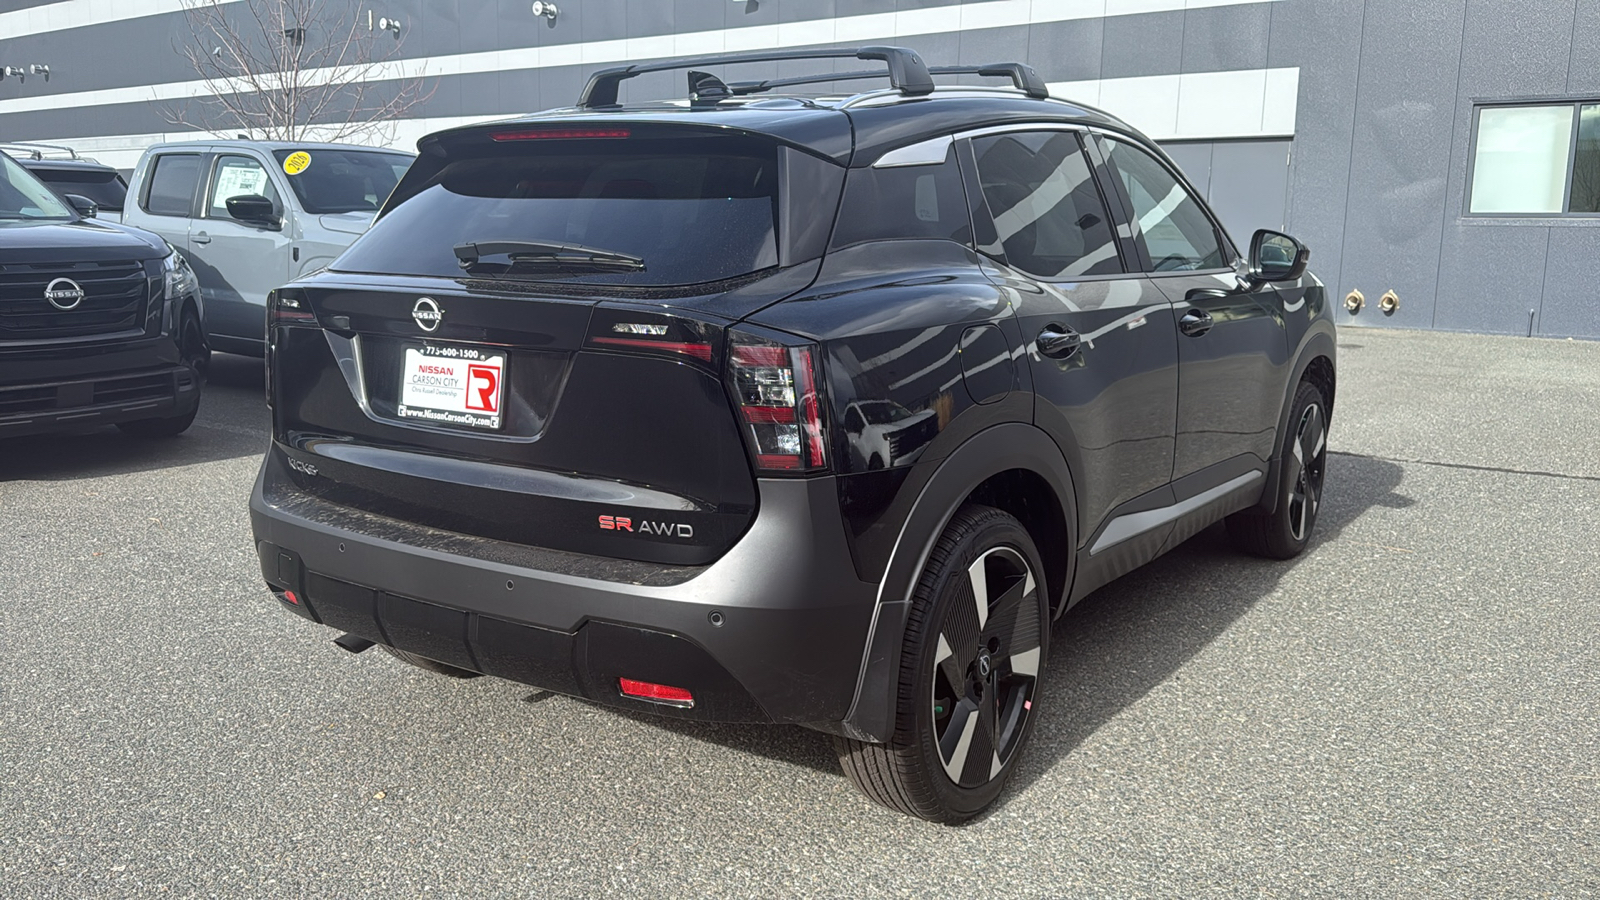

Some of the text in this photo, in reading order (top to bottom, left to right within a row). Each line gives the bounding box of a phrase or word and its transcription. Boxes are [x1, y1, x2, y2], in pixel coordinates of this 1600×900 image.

[288, 153, 308, 171] 2026
[44, 290, 84, 298] NISSAN
[412, 311, 442, 320] NISSAN
[426, 346, 478, 359] 775-600-1500
[418, 365, 454, 376] NISSAN
[412, 374, 459, 387] CARSON CITY
[472, 369, 496, 411] R
[406, 408, 490, 426] www.NissanCarsonCity.com
[288, 457, 318, 476] KICKS
[598, 515, 694, 538] SR AWD
